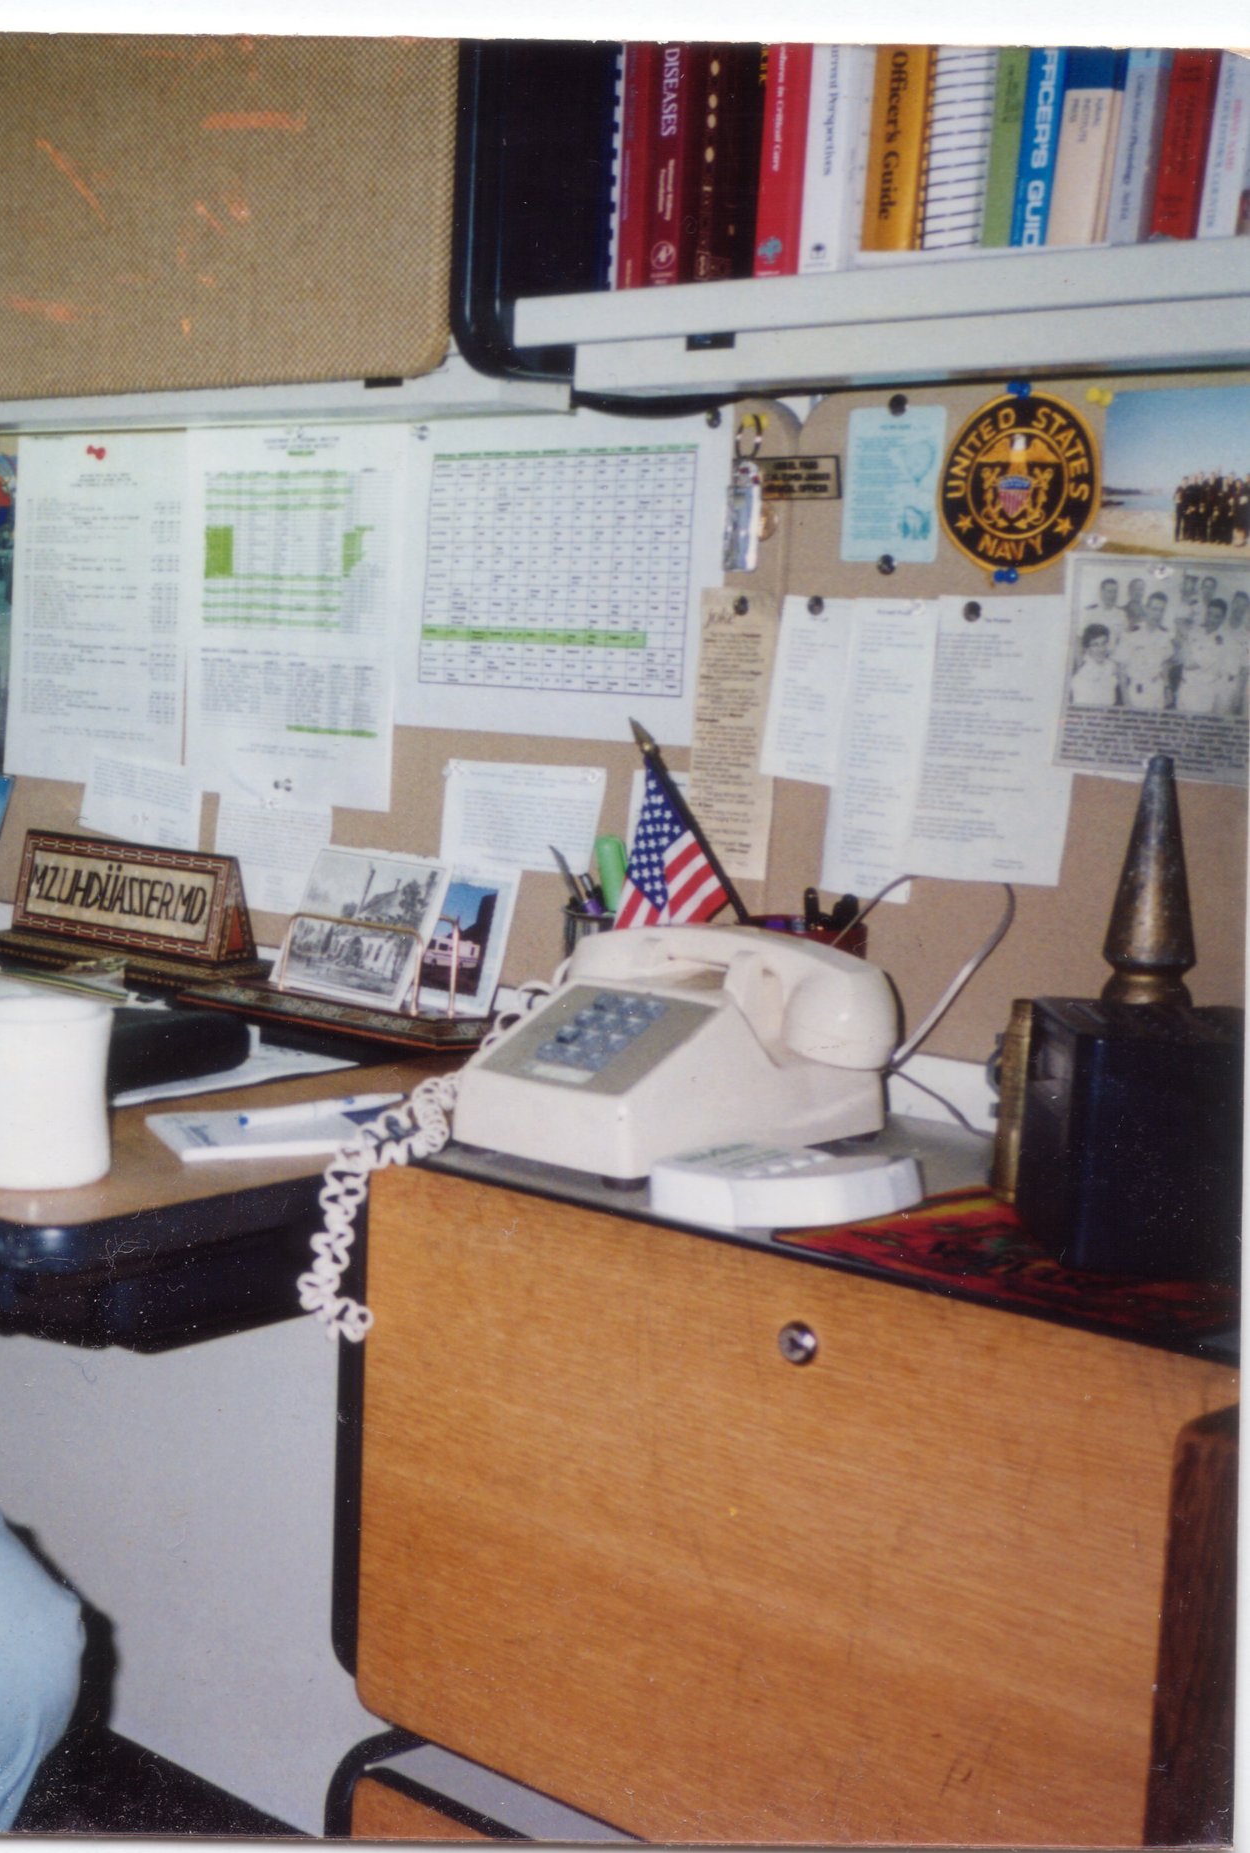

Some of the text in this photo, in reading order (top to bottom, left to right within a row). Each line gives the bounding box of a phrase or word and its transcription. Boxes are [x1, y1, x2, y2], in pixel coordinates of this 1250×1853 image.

[661, 47, 680, 136] DISEASES
[770, 101, 784, 142] Critical
[823, 92, 838, 176] Perspectives
[878, 51, 909, 220] Officer's Guide
[667, 159, 675, 192] National
[770, 144, 781, 171] Care
[1123, 135, 1138, 186] Physiology
[657, 168, 666, 213] Foundation
[946, 407, 1016, 498] UNITED
[1032, 406, 1090, 501] STATES
[977, 534, 1043, 560] NAVY
